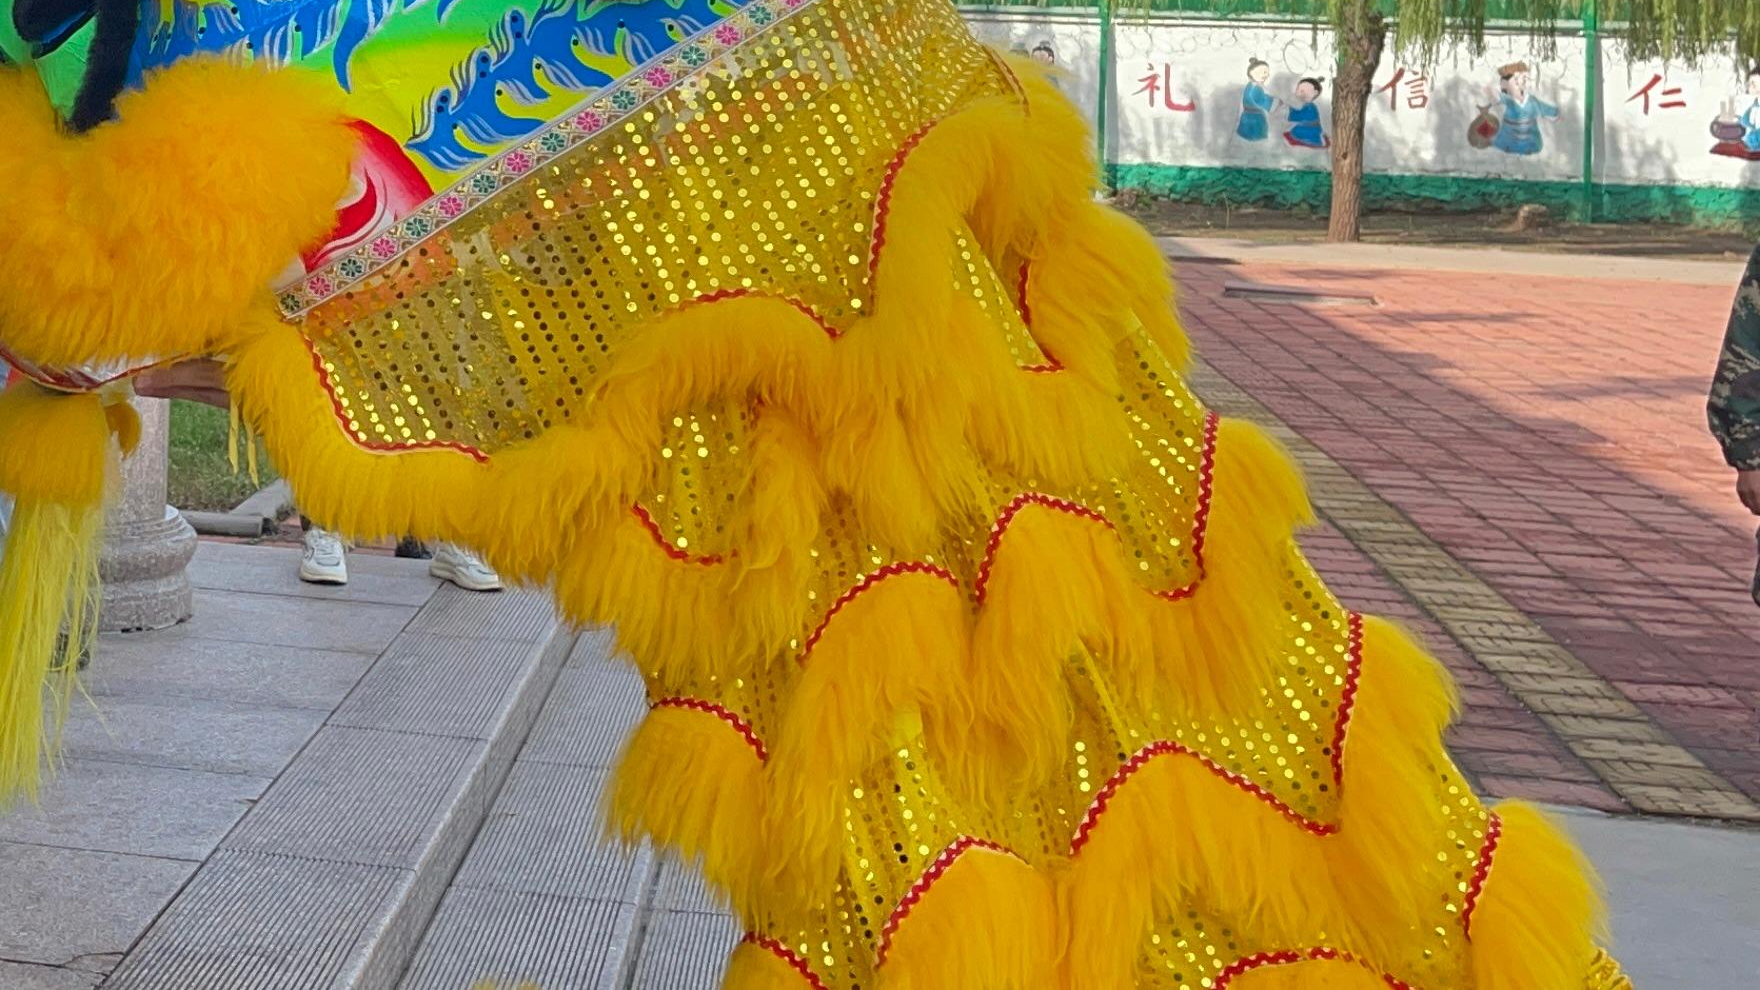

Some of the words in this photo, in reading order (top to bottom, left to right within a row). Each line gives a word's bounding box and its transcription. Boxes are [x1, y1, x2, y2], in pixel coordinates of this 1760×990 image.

[1131, 63, 1196, 112] 礼
[1376, 67, 1429, 111] 信
[1625, 73, 1687, 115] 仁
